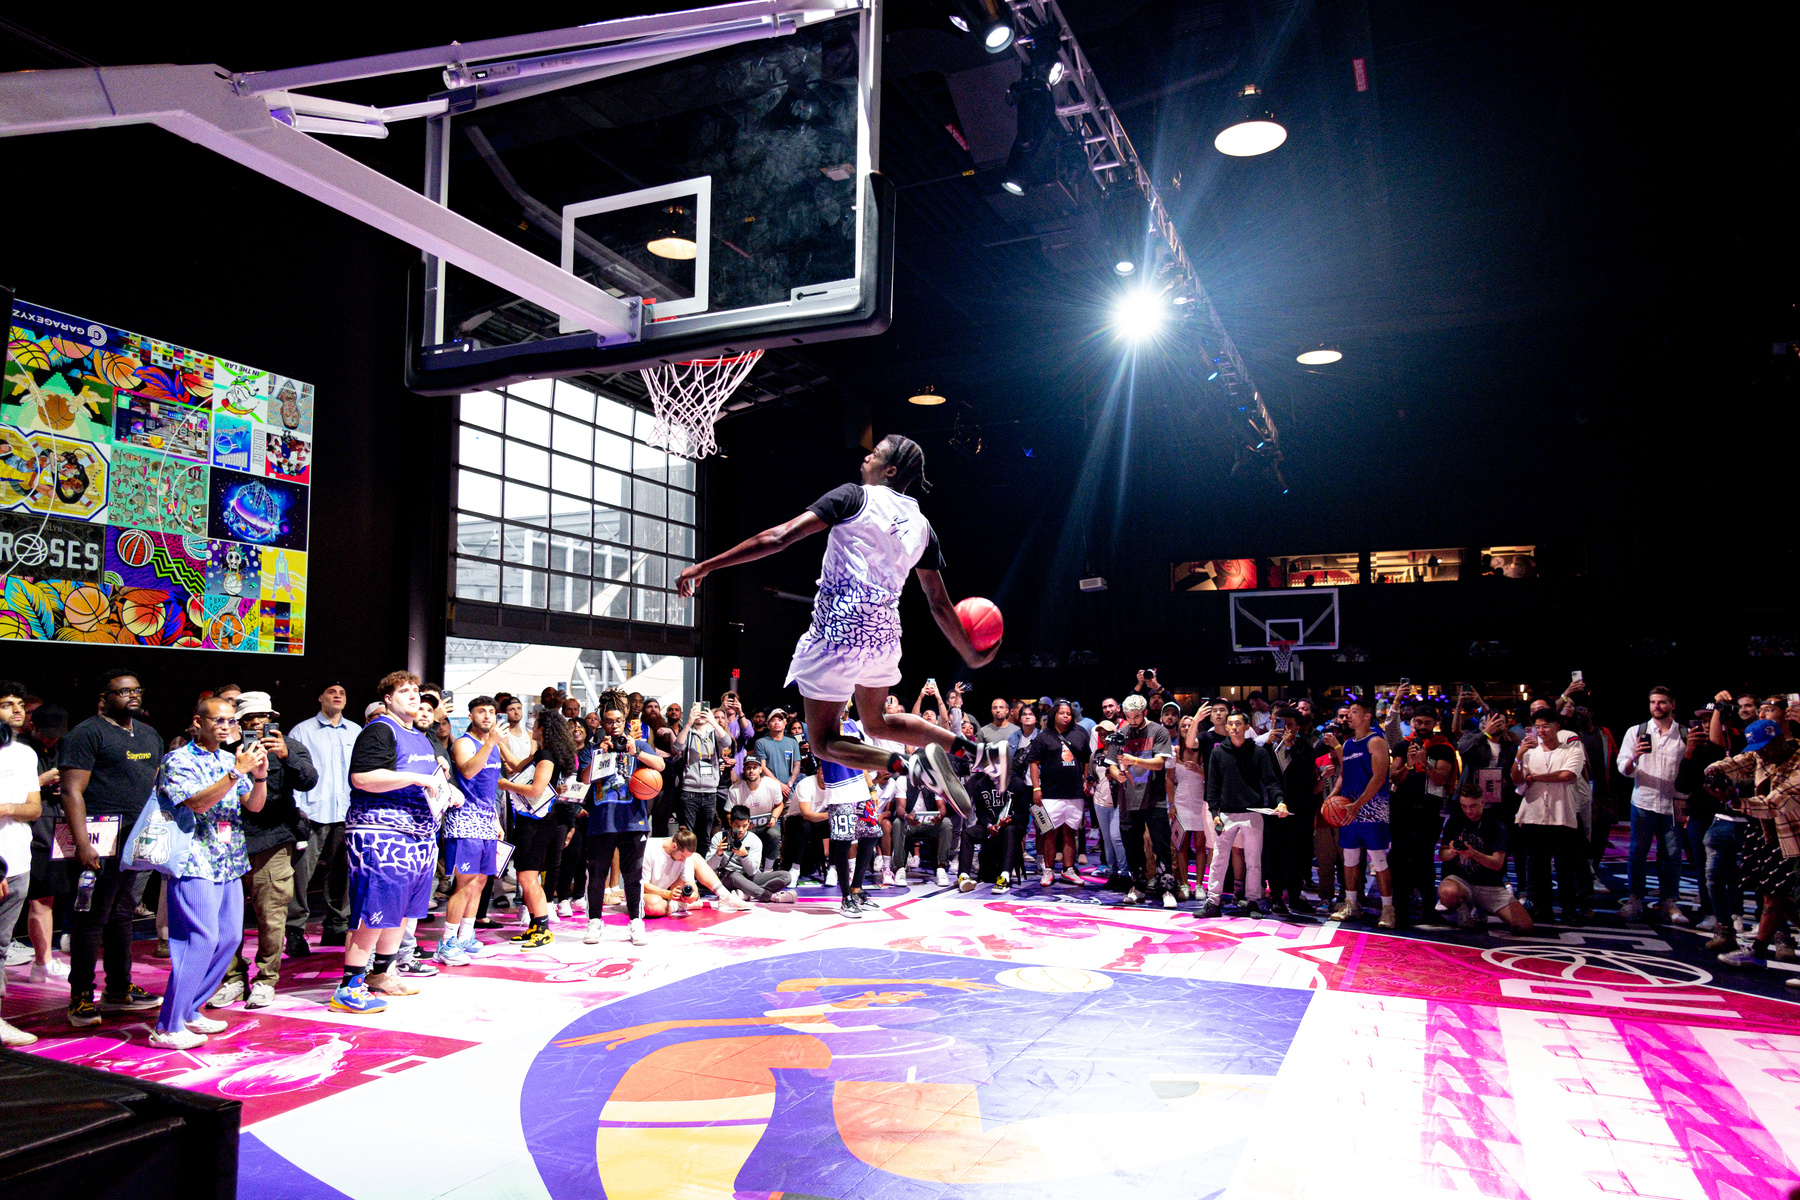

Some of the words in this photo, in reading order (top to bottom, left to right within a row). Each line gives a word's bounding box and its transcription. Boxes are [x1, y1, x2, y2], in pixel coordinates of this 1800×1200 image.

[12, 308, 85, 335] GARAGEXYZ
[224, 361, 238, 370] LAB
[239, 365, 251, 374] THE
[1036, 810, 1047, 826] YEAH
